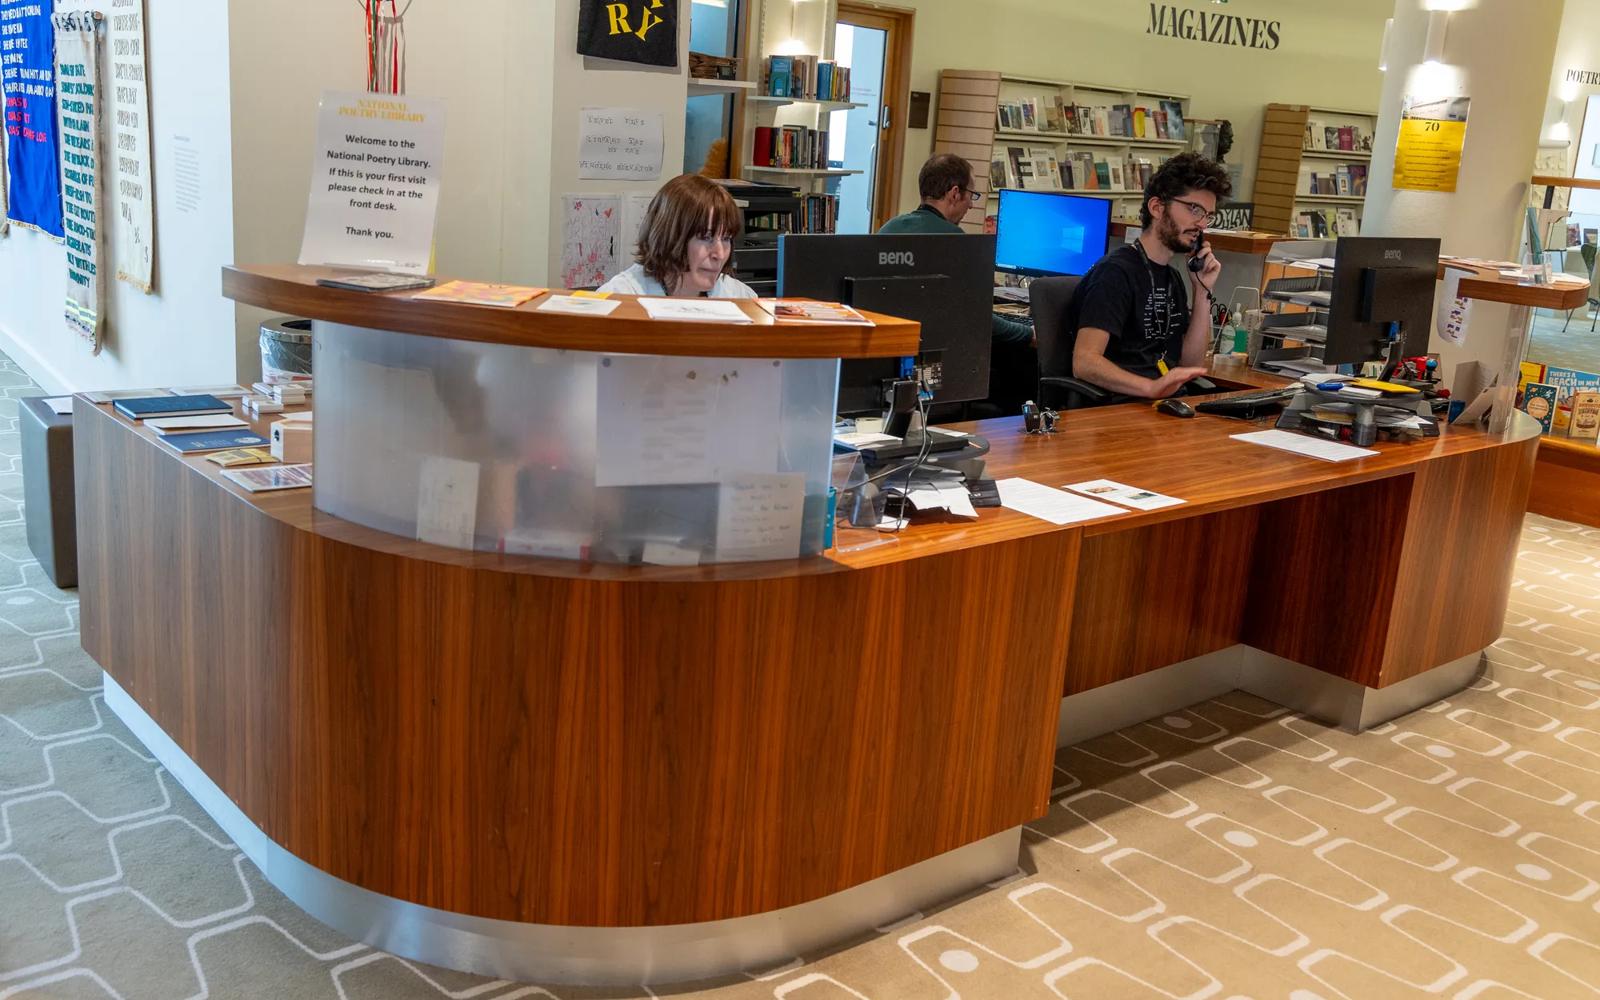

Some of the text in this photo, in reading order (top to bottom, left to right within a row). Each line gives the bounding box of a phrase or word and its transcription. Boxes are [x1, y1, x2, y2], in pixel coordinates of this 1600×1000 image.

[1146, 3, 1281, 50] MAGAZINES
[1566, 69, 1600, 85] POETR
[338, 106, 426, 122] POETRY LIBRARY
[1425, 121, 1440, 132] 70
[345, 134, 416, 149] Welcome to the
[327, 150, 431, 169] National Poetry Library.
[329, 168, 427, 185] If this is your first visit
[328, 182, 423, 199] please check in at the
[349, 198, 397, 211] front desk.
[1215, 208, 1251, 229] DYLAN
[345, 226, 394, 240] Thank you.
[878, 251, 915, 267] BenQ
[1549, 376, 1577, 386] BEACH
